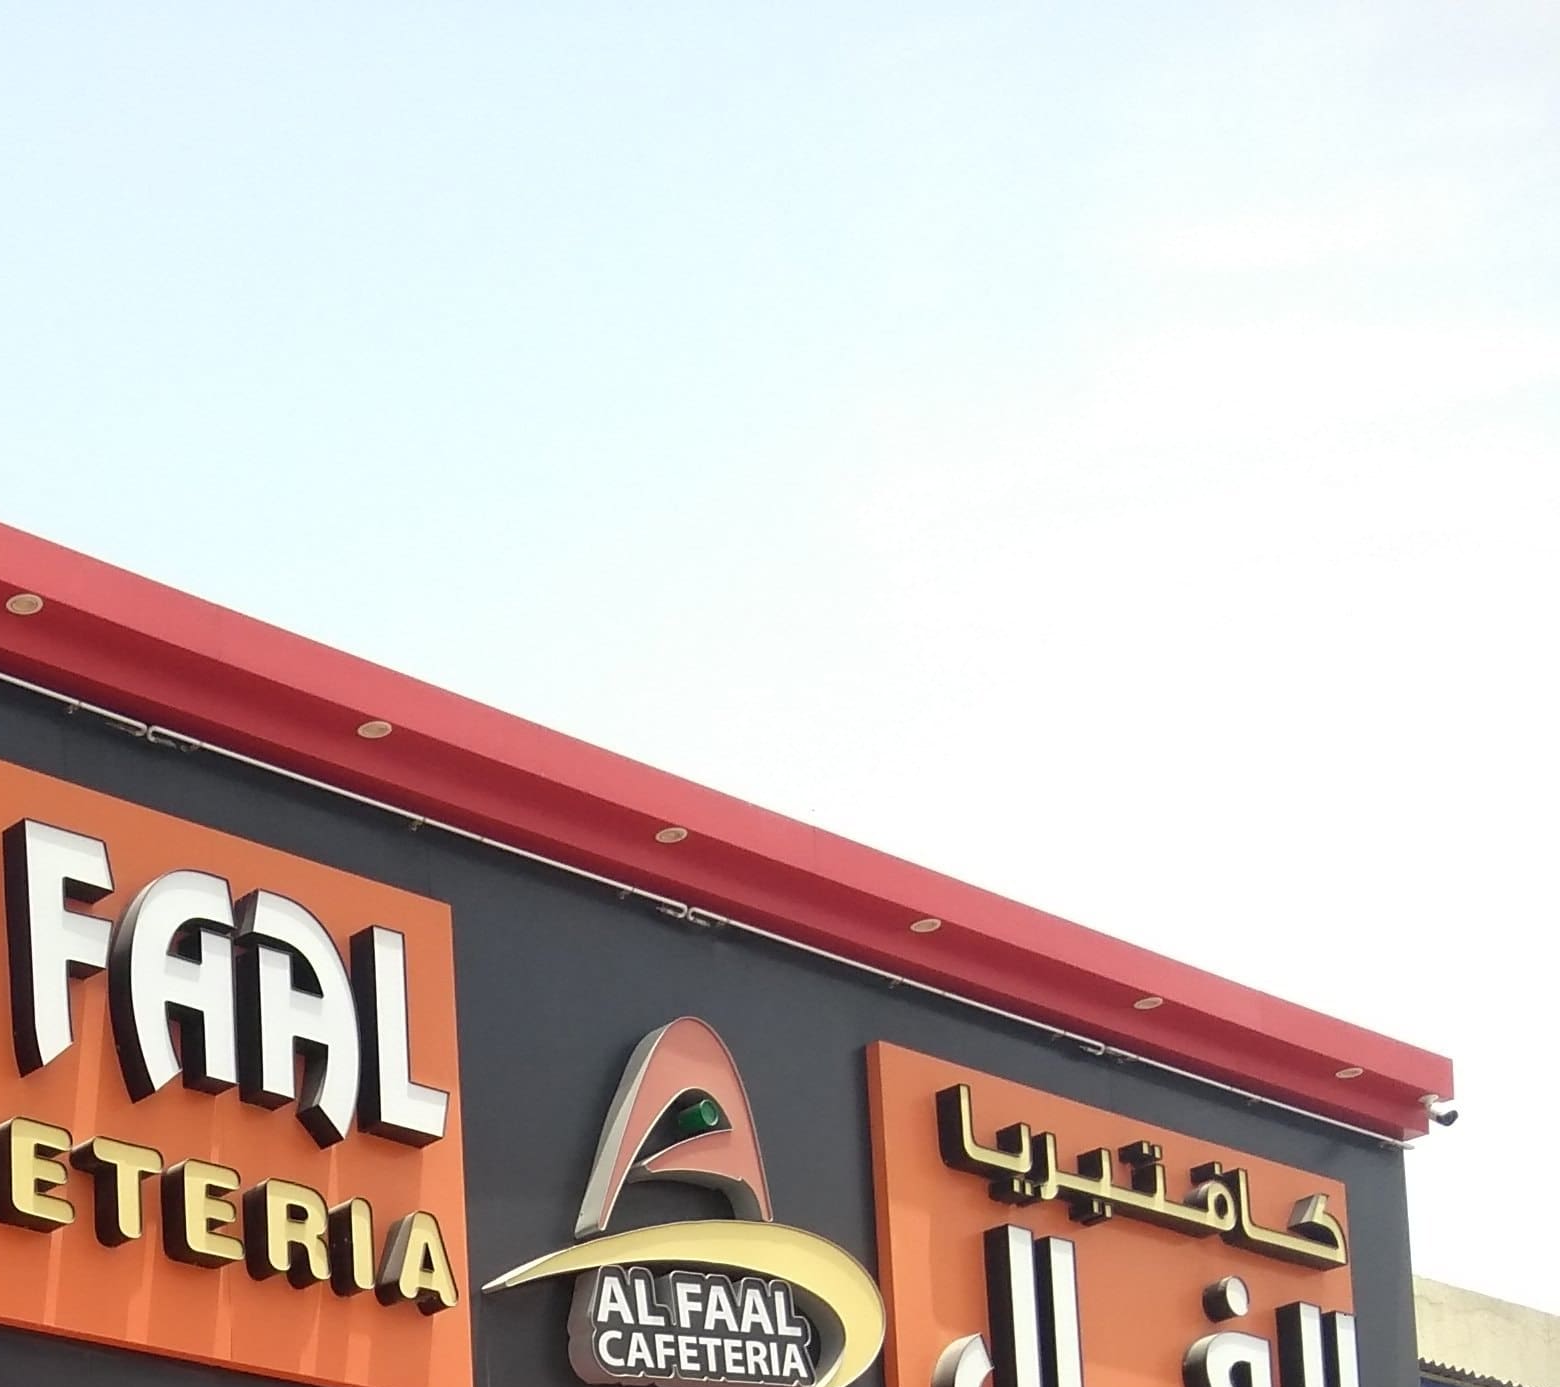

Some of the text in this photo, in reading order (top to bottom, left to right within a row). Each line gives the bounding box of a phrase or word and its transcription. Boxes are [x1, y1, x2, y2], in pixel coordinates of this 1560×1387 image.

[5, 817, 450, 1150] FAAL
[937, 1083, 1349, 1271] كافتيريا
[596, 1276, 803, 1338] AL FAAL
[597, 1330, 809, 1379] CAFETERIA
